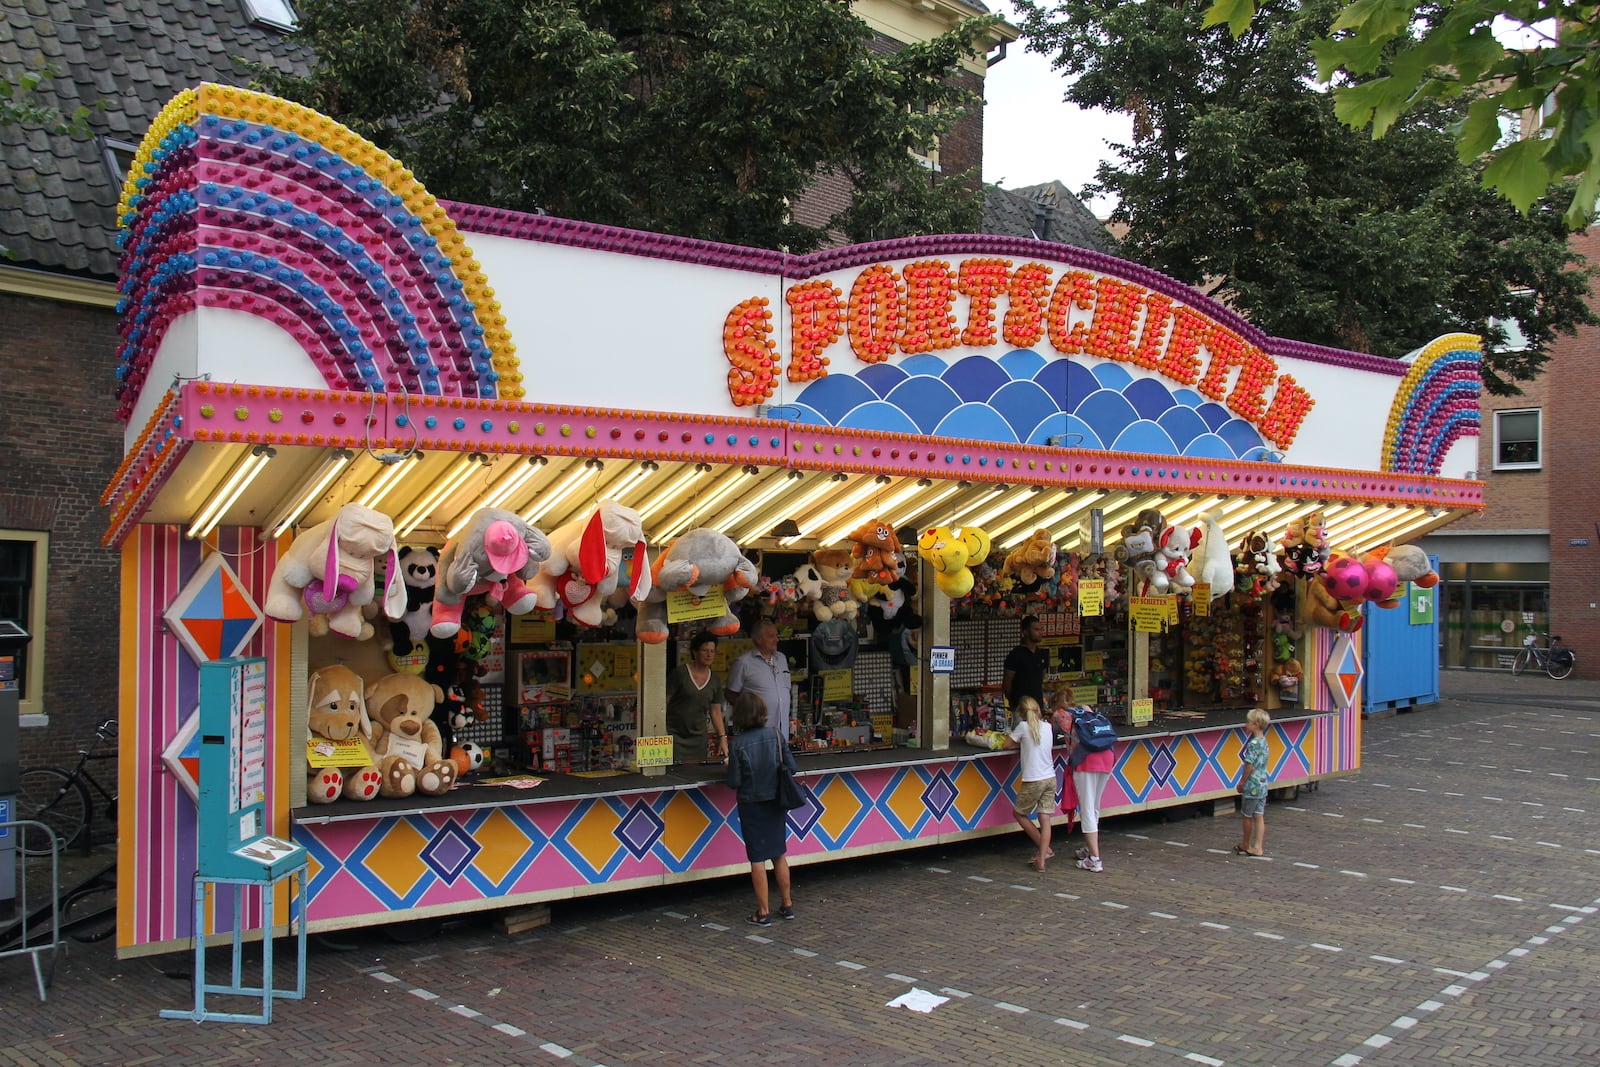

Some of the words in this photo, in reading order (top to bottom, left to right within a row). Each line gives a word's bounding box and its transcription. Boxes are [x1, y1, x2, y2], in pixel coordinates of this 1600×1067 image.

[722, 256, 1316, 450] SPORTSCHIETEN
[1141, 597, 1167, 606] SCHIETEN
[638, 736, 673, 747] KINDEREN
